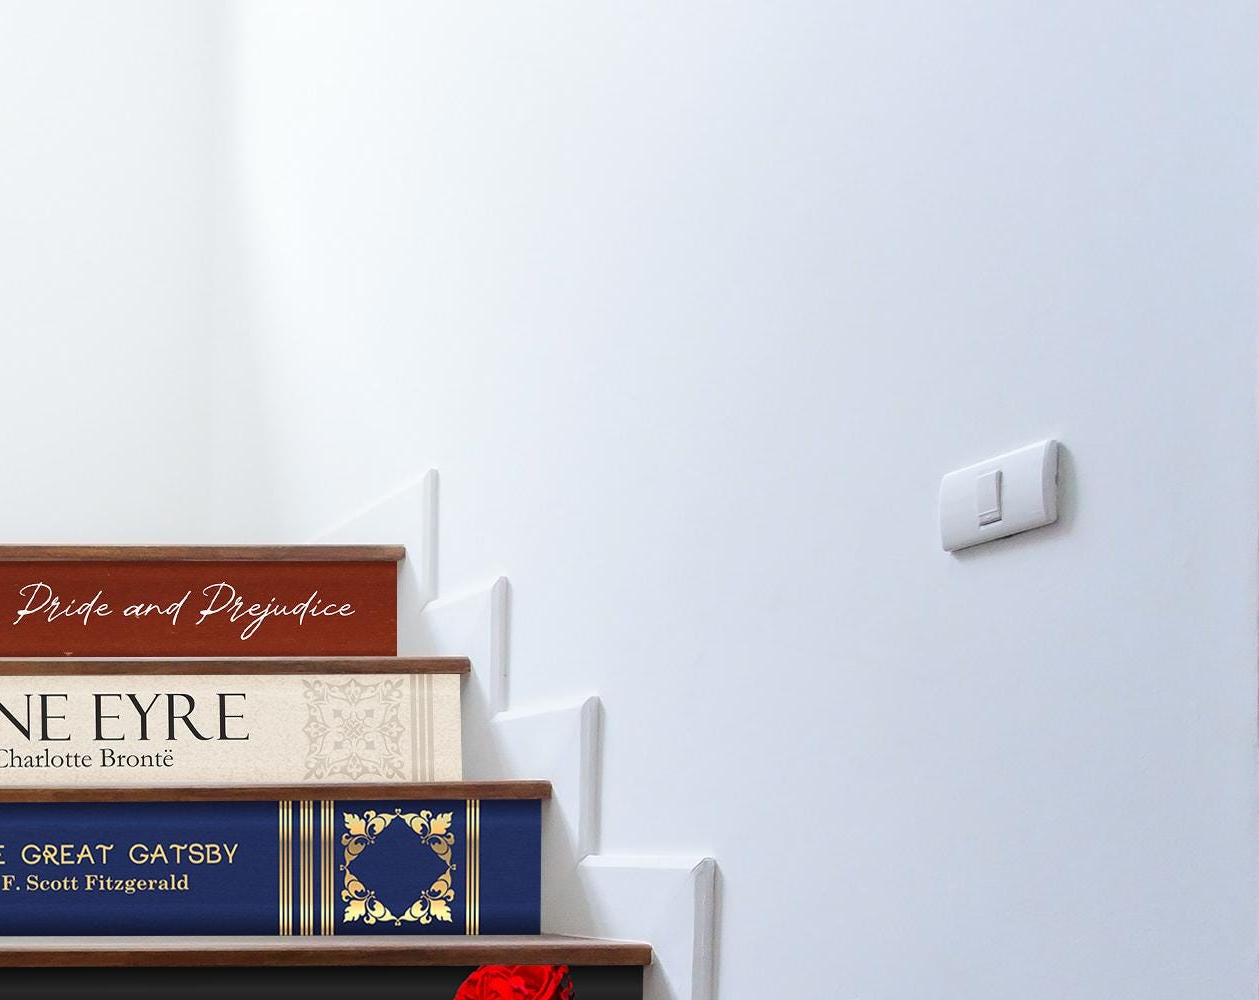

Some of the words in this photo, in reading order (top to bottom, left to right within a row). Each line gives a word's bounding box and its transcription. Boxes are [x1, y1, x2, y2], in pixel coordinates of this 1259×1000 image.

[13, 582, 112, 625] Pride
[123, 590, 192, 626] and
[195, 582, 355, 640] Prejudice
[92, 694, 249, 740] EYRE
[100, 749, 173, 767] Brontë
[22, 845, 113, 865] GREAT
[129, 844, 238, 864] GATSBY
[1, 875, 20, 891] F.
[27, 875, 78, 890] Scott
[85, 875, 189, 894] Fitzgerald
